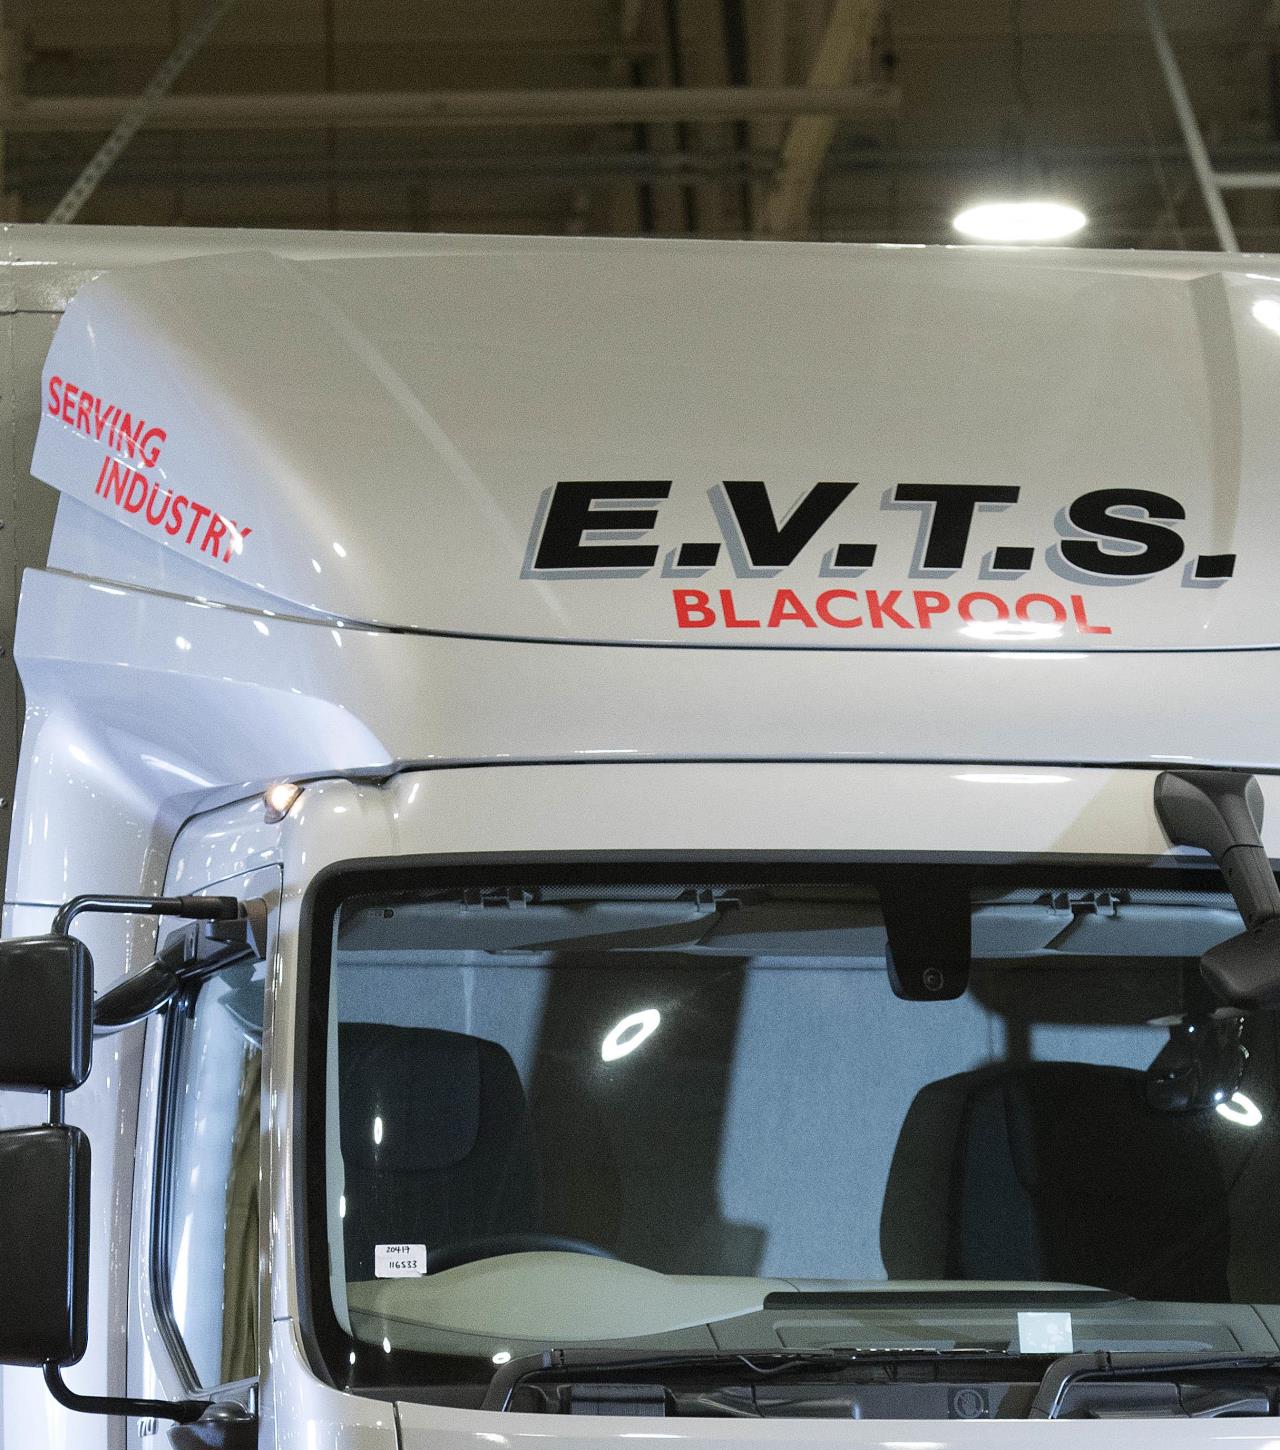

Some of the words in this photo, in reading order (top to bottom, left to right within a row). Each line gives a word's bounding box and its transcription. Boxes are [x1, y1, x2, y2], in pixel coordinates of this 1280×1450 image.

[47, 375, 167, 468] SERVING
[94, 455, 252, 564] INDUSTRY
[520, 480, 1237, 589] E.V.T.S.
[672, 589, 1112, 636] BLACKPOOL
